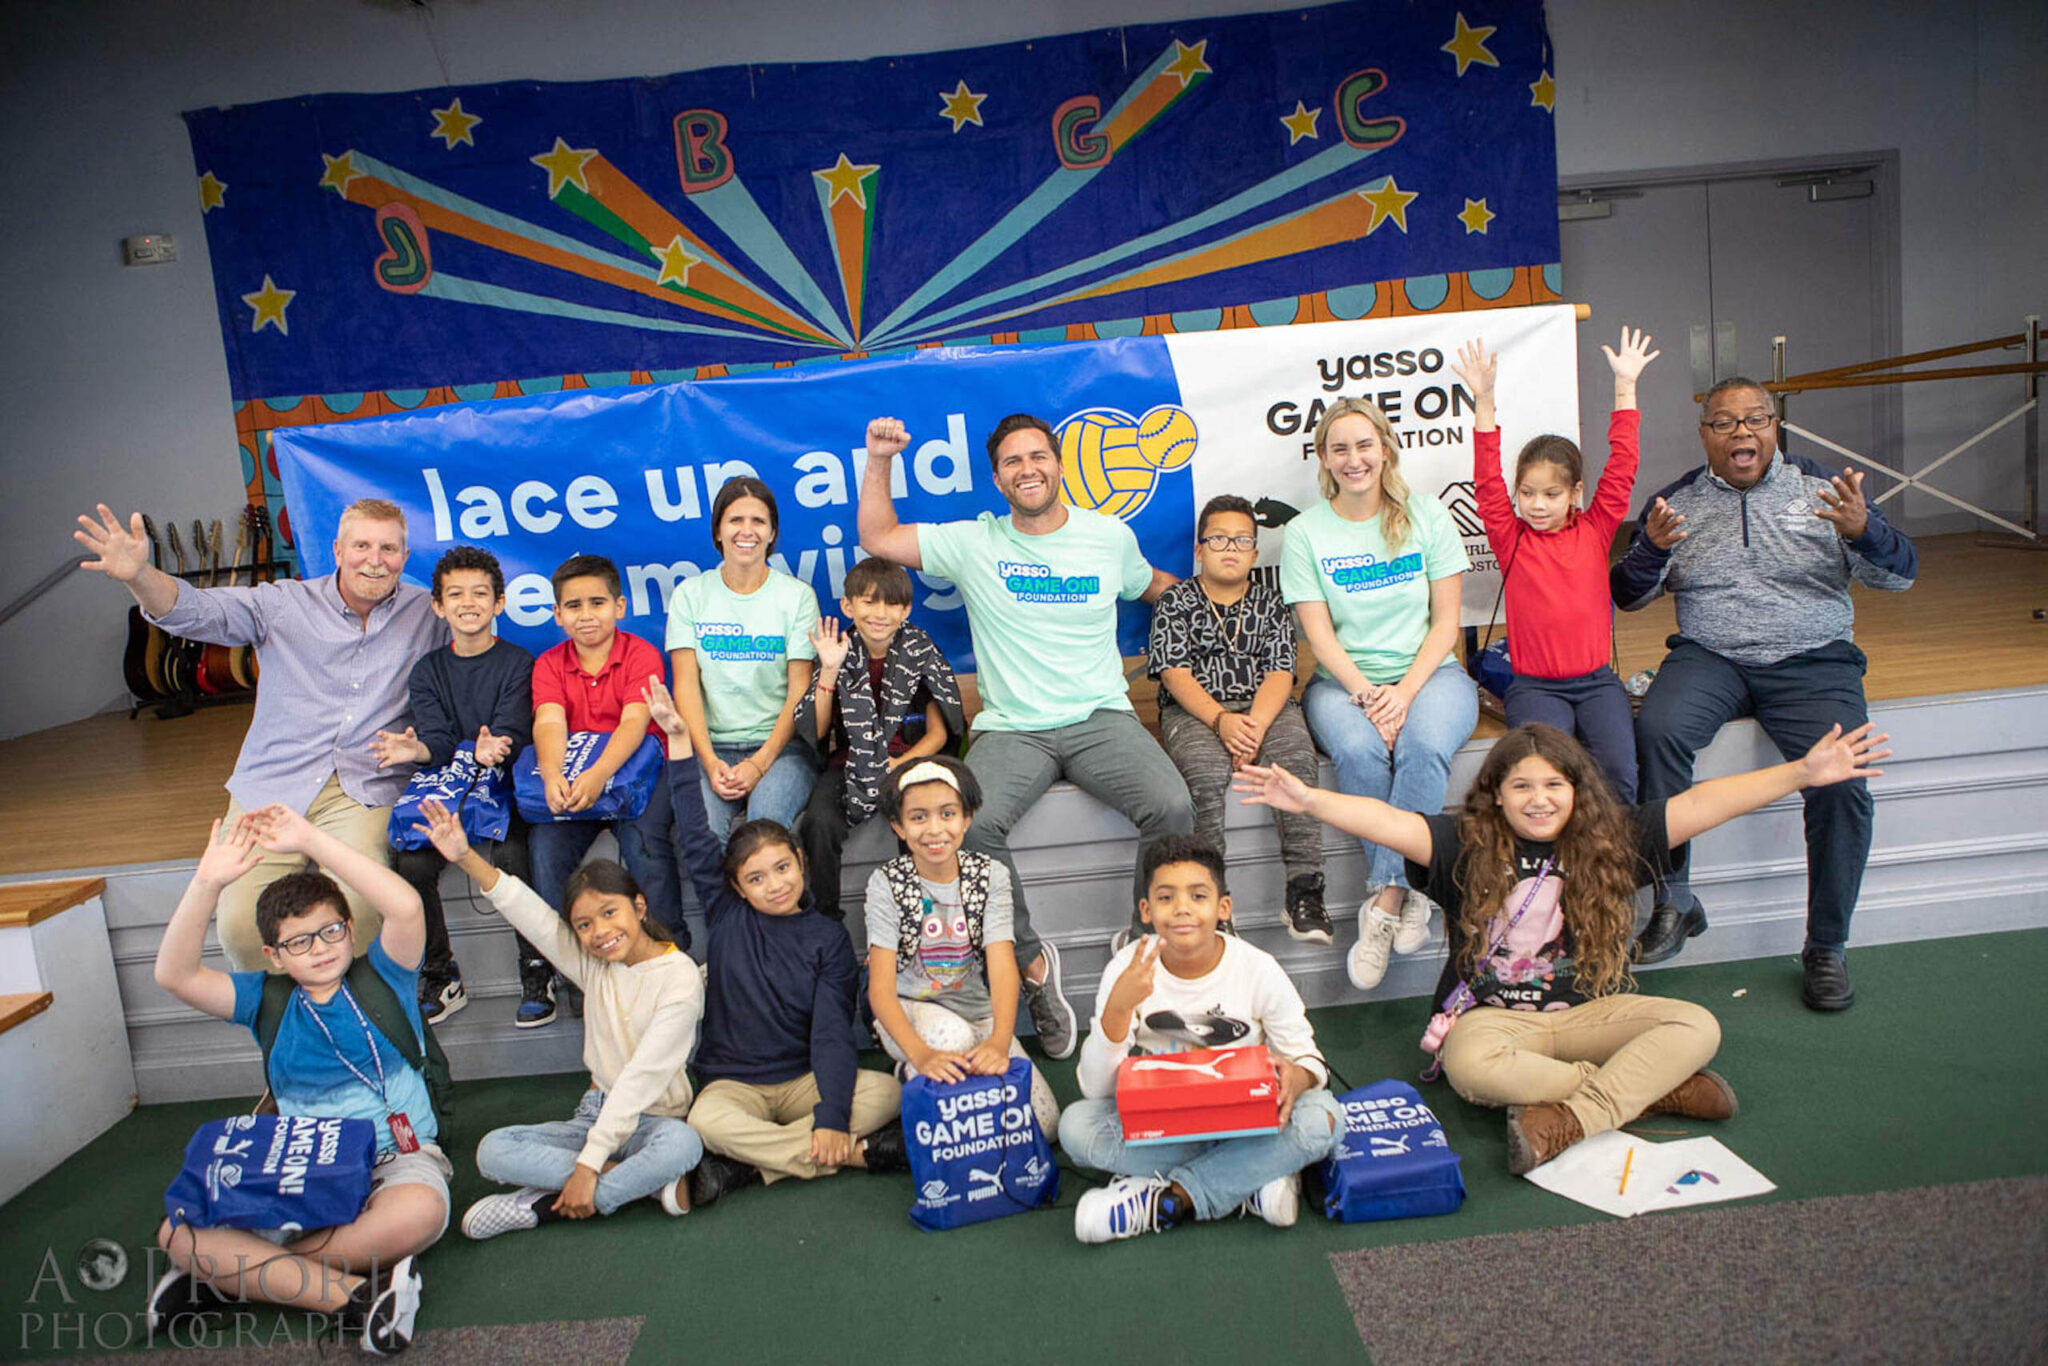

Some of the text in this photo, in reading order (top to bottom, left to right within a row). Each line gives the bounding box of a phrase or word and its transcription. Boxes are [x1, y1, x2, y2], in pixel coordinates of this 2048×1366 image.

[673, 109, 735, 195] B
[1052, 95, 1113, 170] G
[1334, 68, 1406, 150] C
[1317, 348, 1444, 392] yasso
[1266, 383, 1480, 436] GAE ON
[422, 468, 619, 542] lace
[999, 562, 1050, 578] yasso
[1322, 555, 1374, 575] yasso
[1334, 563, 1388, 585] GAME
[1462, 560, 1501, 573] OSTO
[1007, 576, 1098, 593] GAME ON!
[1346, 573, 1413, 592] FOUNDATION
[1017, 592, 1087, 602] FOUNDATION
[696, 623, 743, 639] yasso
[702, 636, 752, 651] GAME
[711, 651, 775, 660] FOUNDATION
[937, 1085, 1018, 1121] yasso
[286, 1116, 318, 1155] AME
[317, 1118, 343, 1166] yasso
[915, 1112, 995, 1147] GAME
[262, 1116, 290, 1174] FOUNDATION
[932, 1128, 1033, 1163] FOUNDATION
